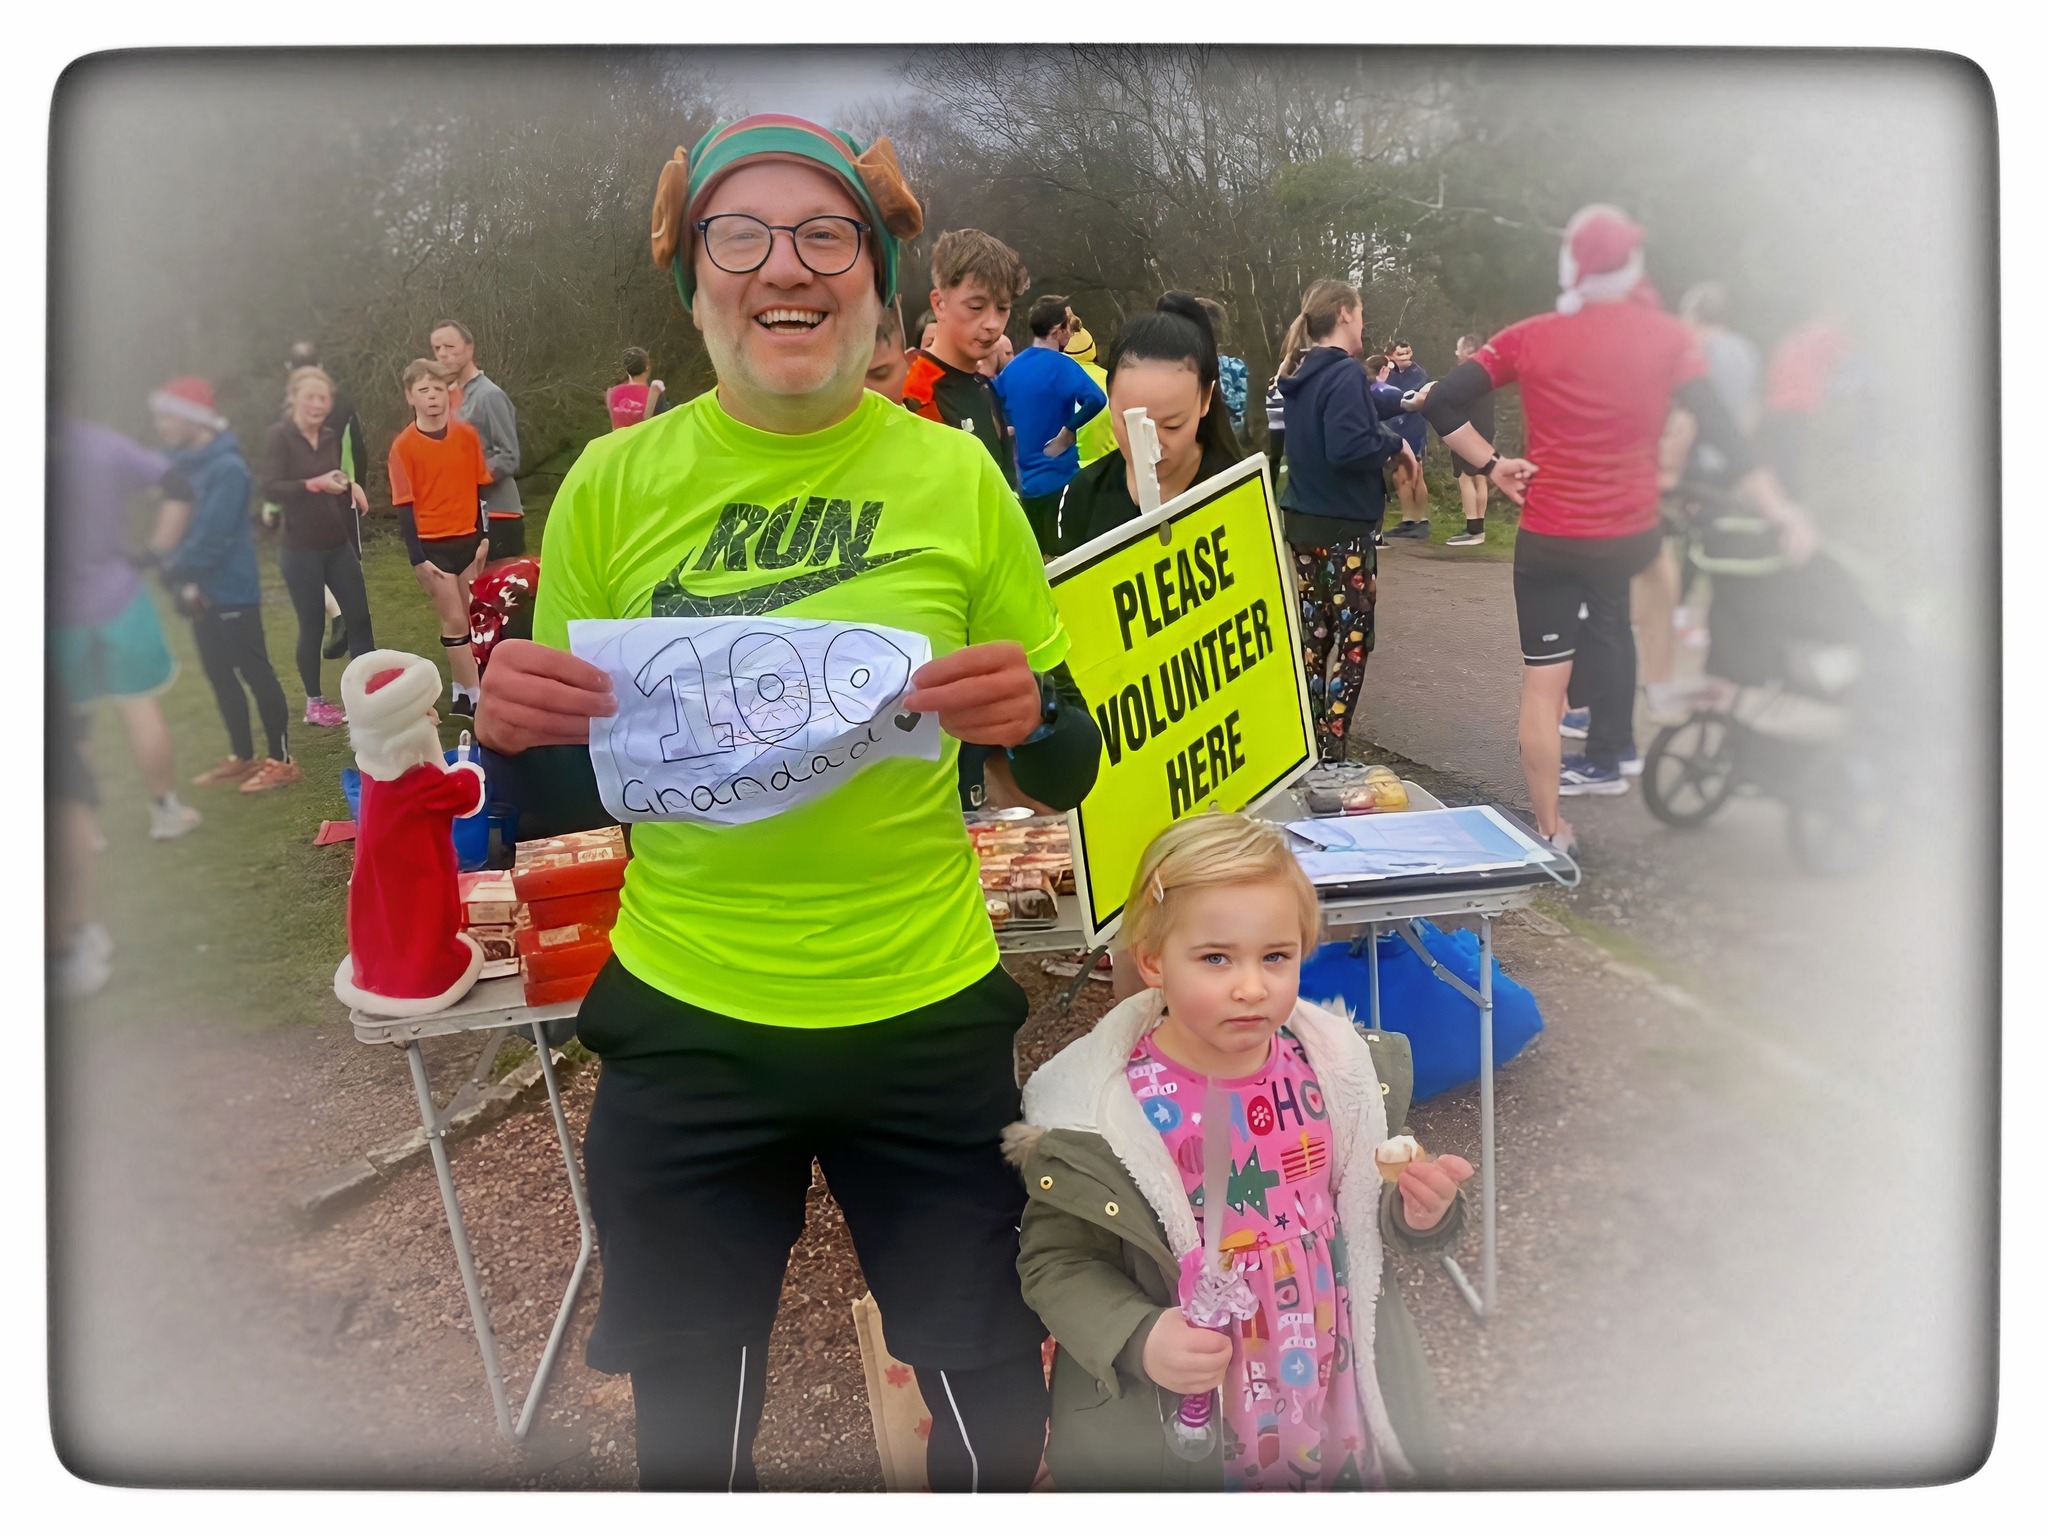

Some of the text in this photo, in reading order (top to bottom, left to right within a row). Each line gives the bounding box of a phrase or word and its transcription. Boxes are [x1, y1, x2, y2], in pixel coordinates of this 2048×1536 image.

[692, 497, 884, 571] RUN
[1113, 525, 1235, 651] PLEASE
[634, 629, 911, 763] 100
[1096, 598, 1273, 767] VOLUNTEER
[622, 730, 882, 815] Grandad
[1166, 709, 1246, 821] HERE
